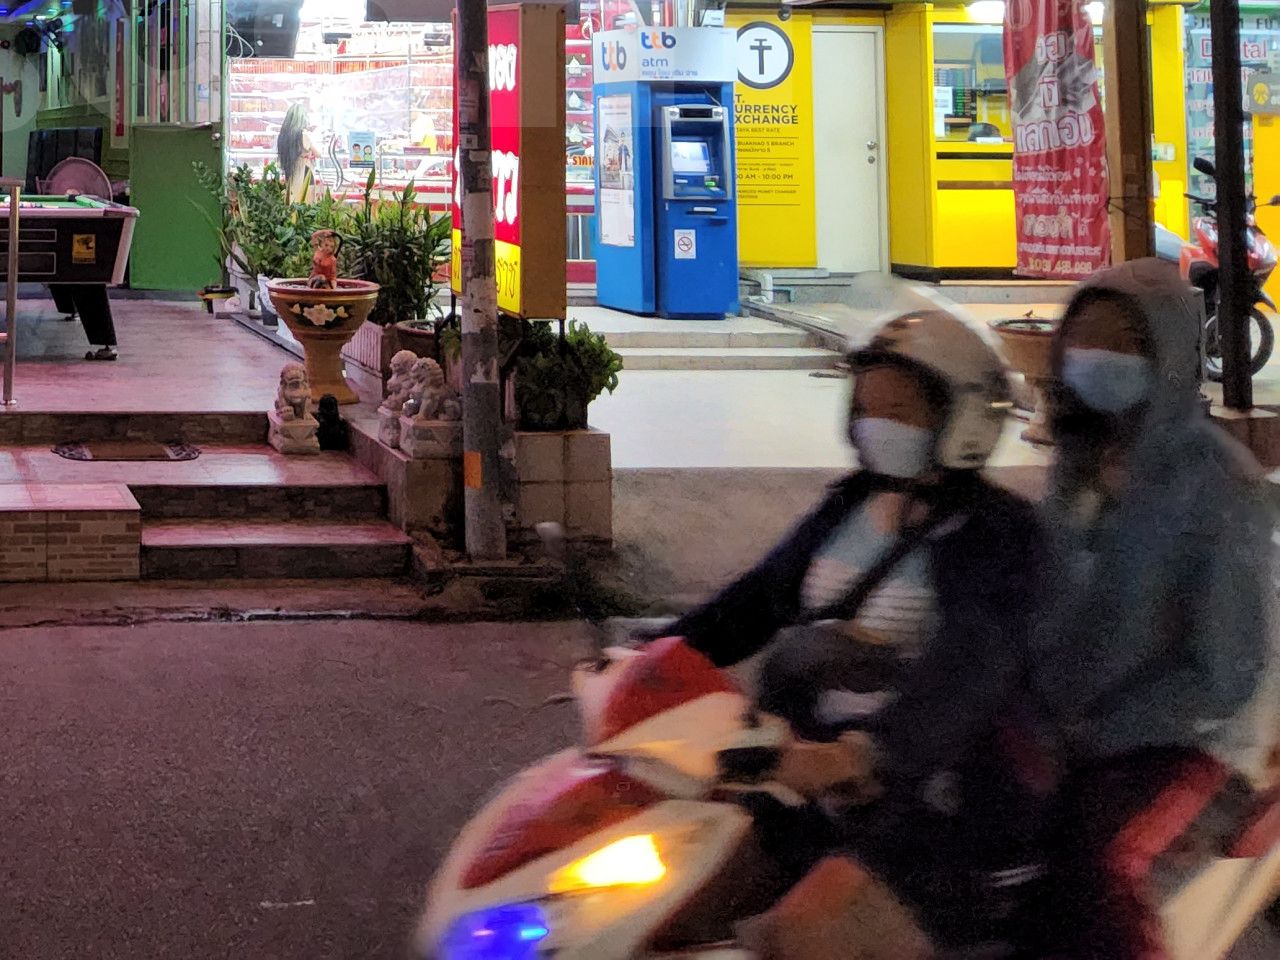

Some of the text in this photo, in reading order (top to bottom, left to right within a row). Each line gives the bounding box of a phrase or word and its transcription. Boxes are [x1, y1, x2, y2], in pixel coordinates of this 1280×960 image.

[640, 31, 677, 50] ttb
[601, 40, 627, 71] ttb
[641, 57, 669, 68] atm
[734, 104, 798, 114] URRENCY
[734, 115, 799, 125] XCHANGE
